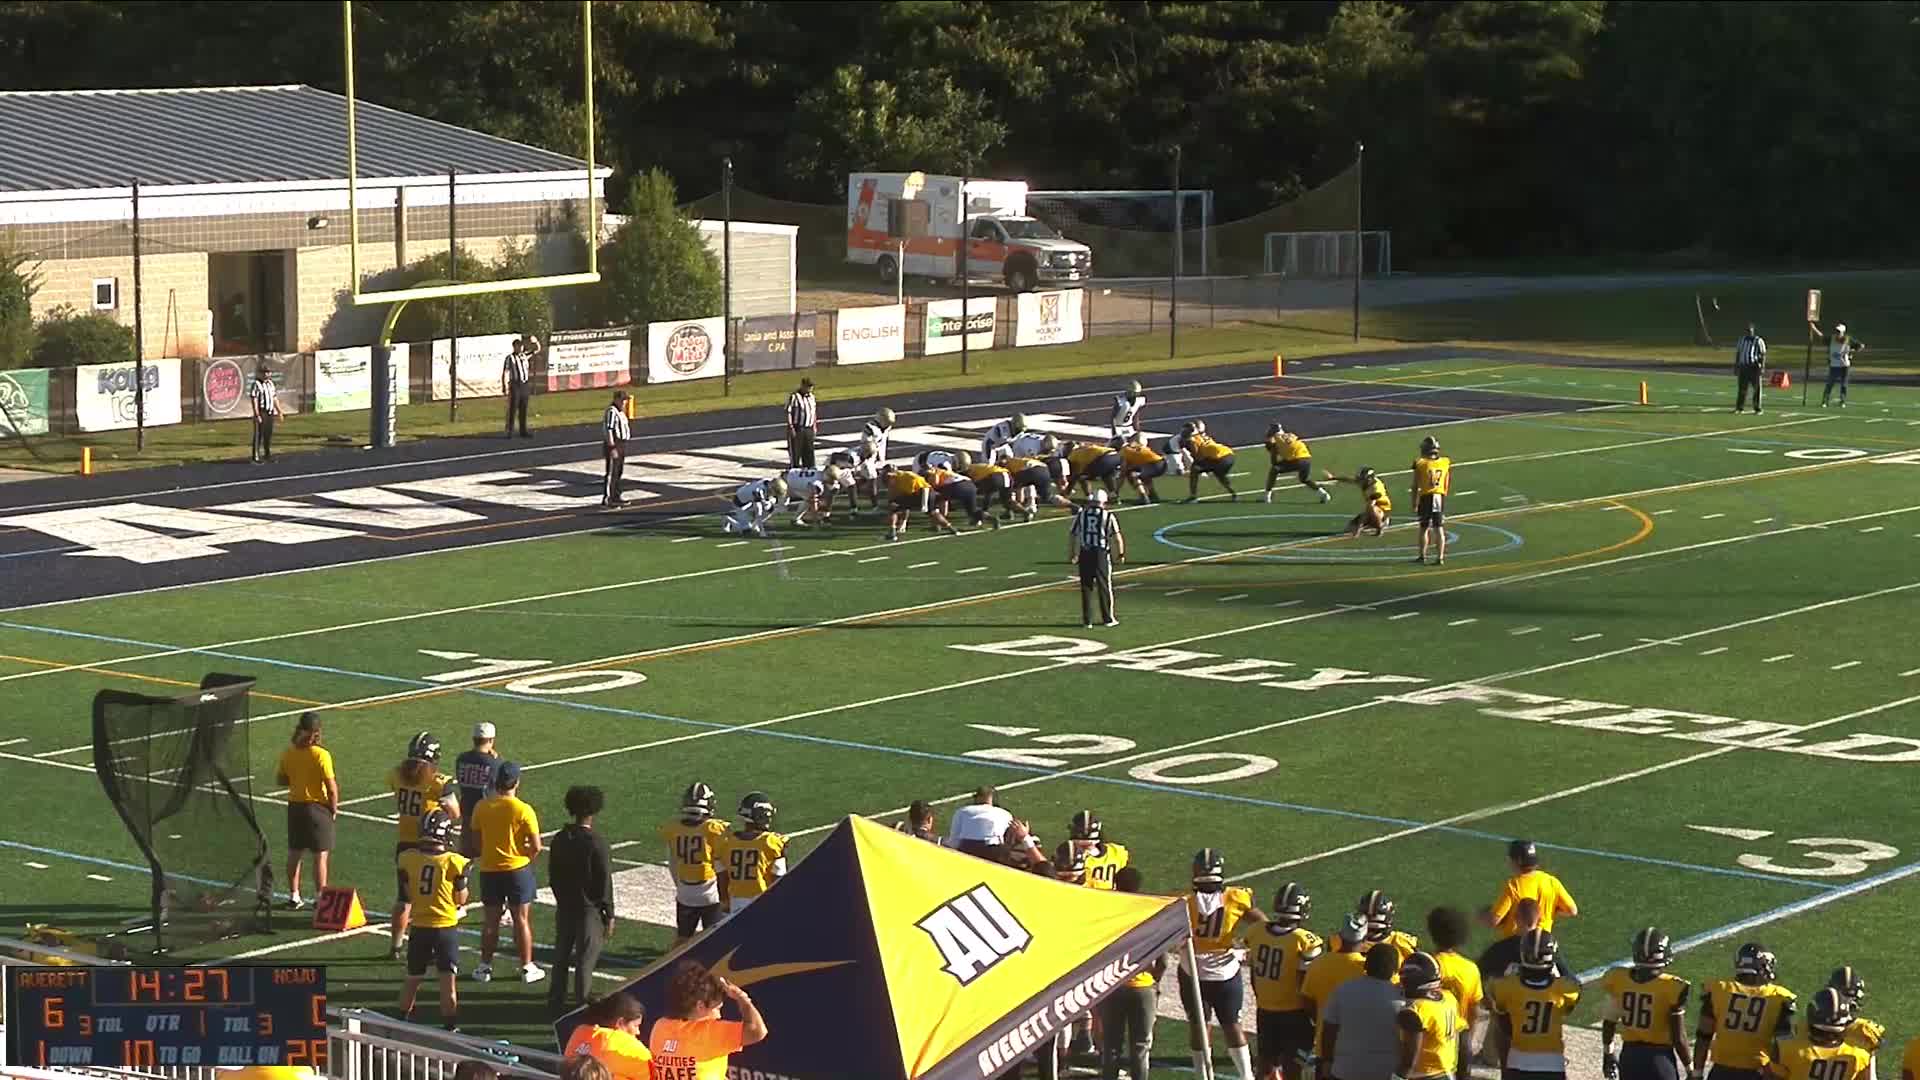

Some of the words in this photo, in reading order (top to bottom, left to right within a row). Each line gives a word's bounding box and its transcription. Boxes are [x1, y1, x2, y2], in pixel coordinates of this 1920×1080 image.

[842, 325, 900, 341] ENGLISH
[930, 316, 993, 332] enteprise
[1087, 515, 1099, 533] R
[420, 655, 647, 695] 10
[962, 733, 1279, 785] 20
[676, 835, 703, 865] 42
[731, 849, 759, 880] 92
[420, 864, 434, 896] 9
[913, 881, 1034, 987] AU
[1257, 944, 1284, 980] 98
[1521, 1000, 1553, 1034] 31
[1622, 991, 1653, 1029] 96
[1726, 993, 1767, 1032] 59
